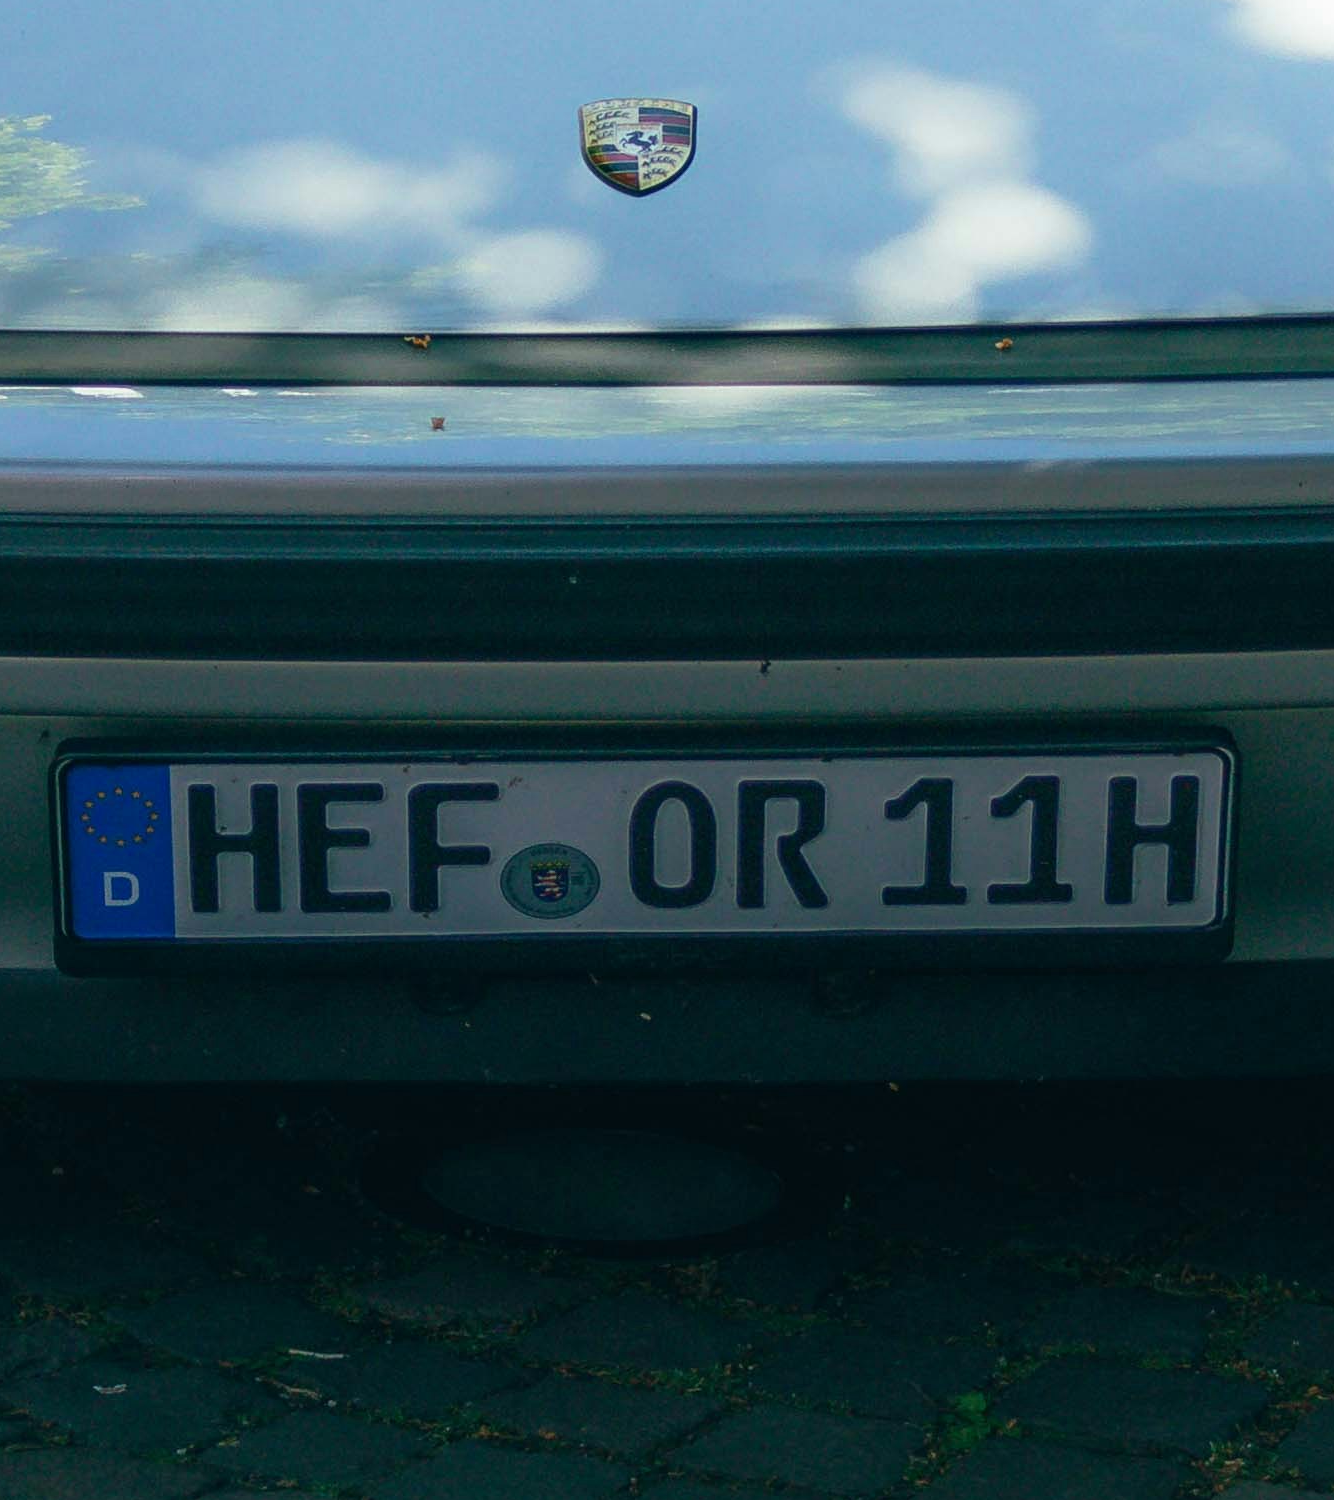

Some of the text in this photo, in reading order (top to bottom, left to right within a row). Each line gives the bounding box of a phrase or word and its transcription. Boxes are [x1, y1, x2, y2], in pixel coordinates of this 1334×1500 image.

[103, 774, 1201, 915] D HEF OR 11H
